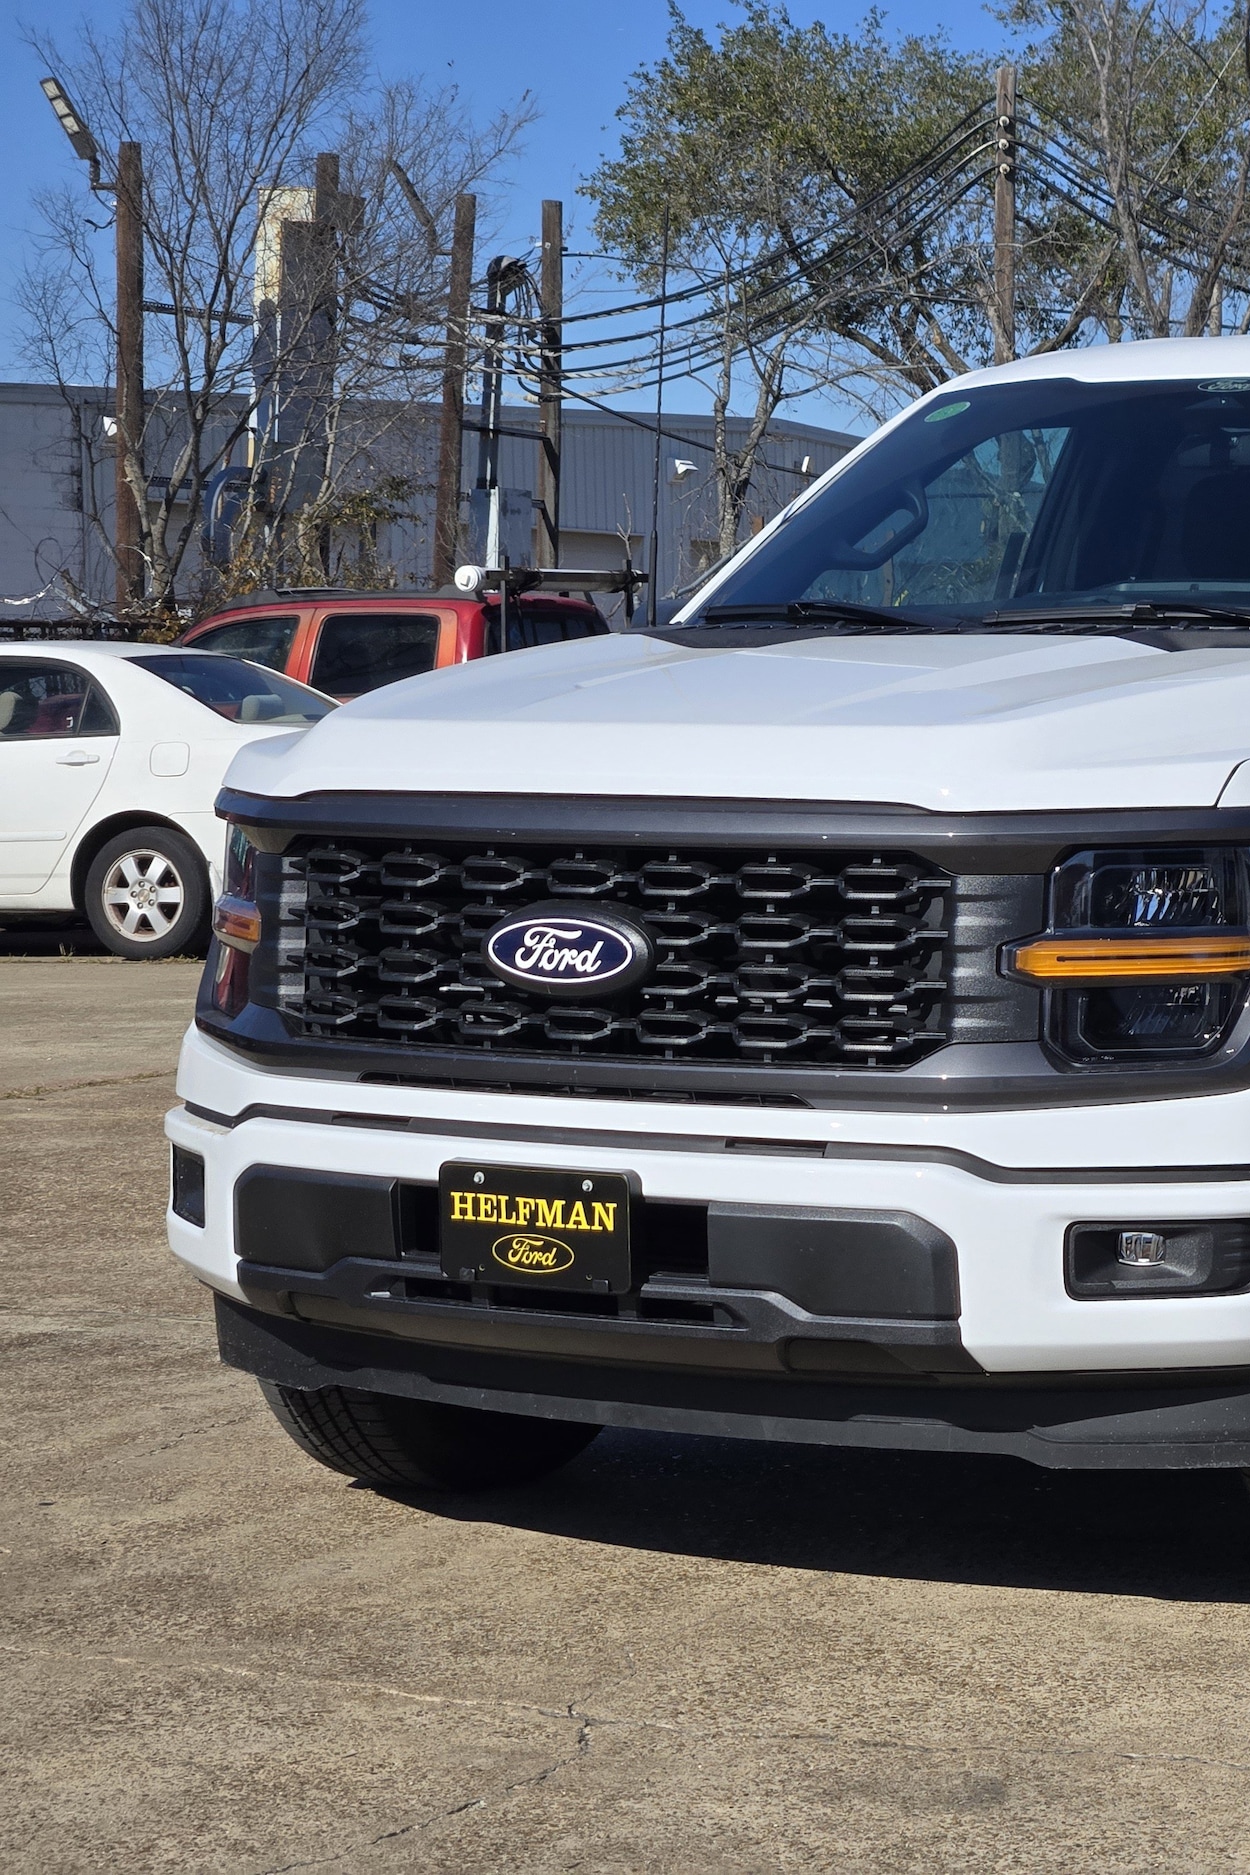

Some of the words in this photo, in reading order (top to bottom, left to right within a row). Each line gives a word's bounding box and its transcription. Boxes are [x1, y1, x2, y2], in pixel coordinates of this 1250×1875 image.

[514, 926, 605, 973] Ford
[450, 1191, 618, 1232] HELFMAN
[507, 1237, 558, 1266] Ford
